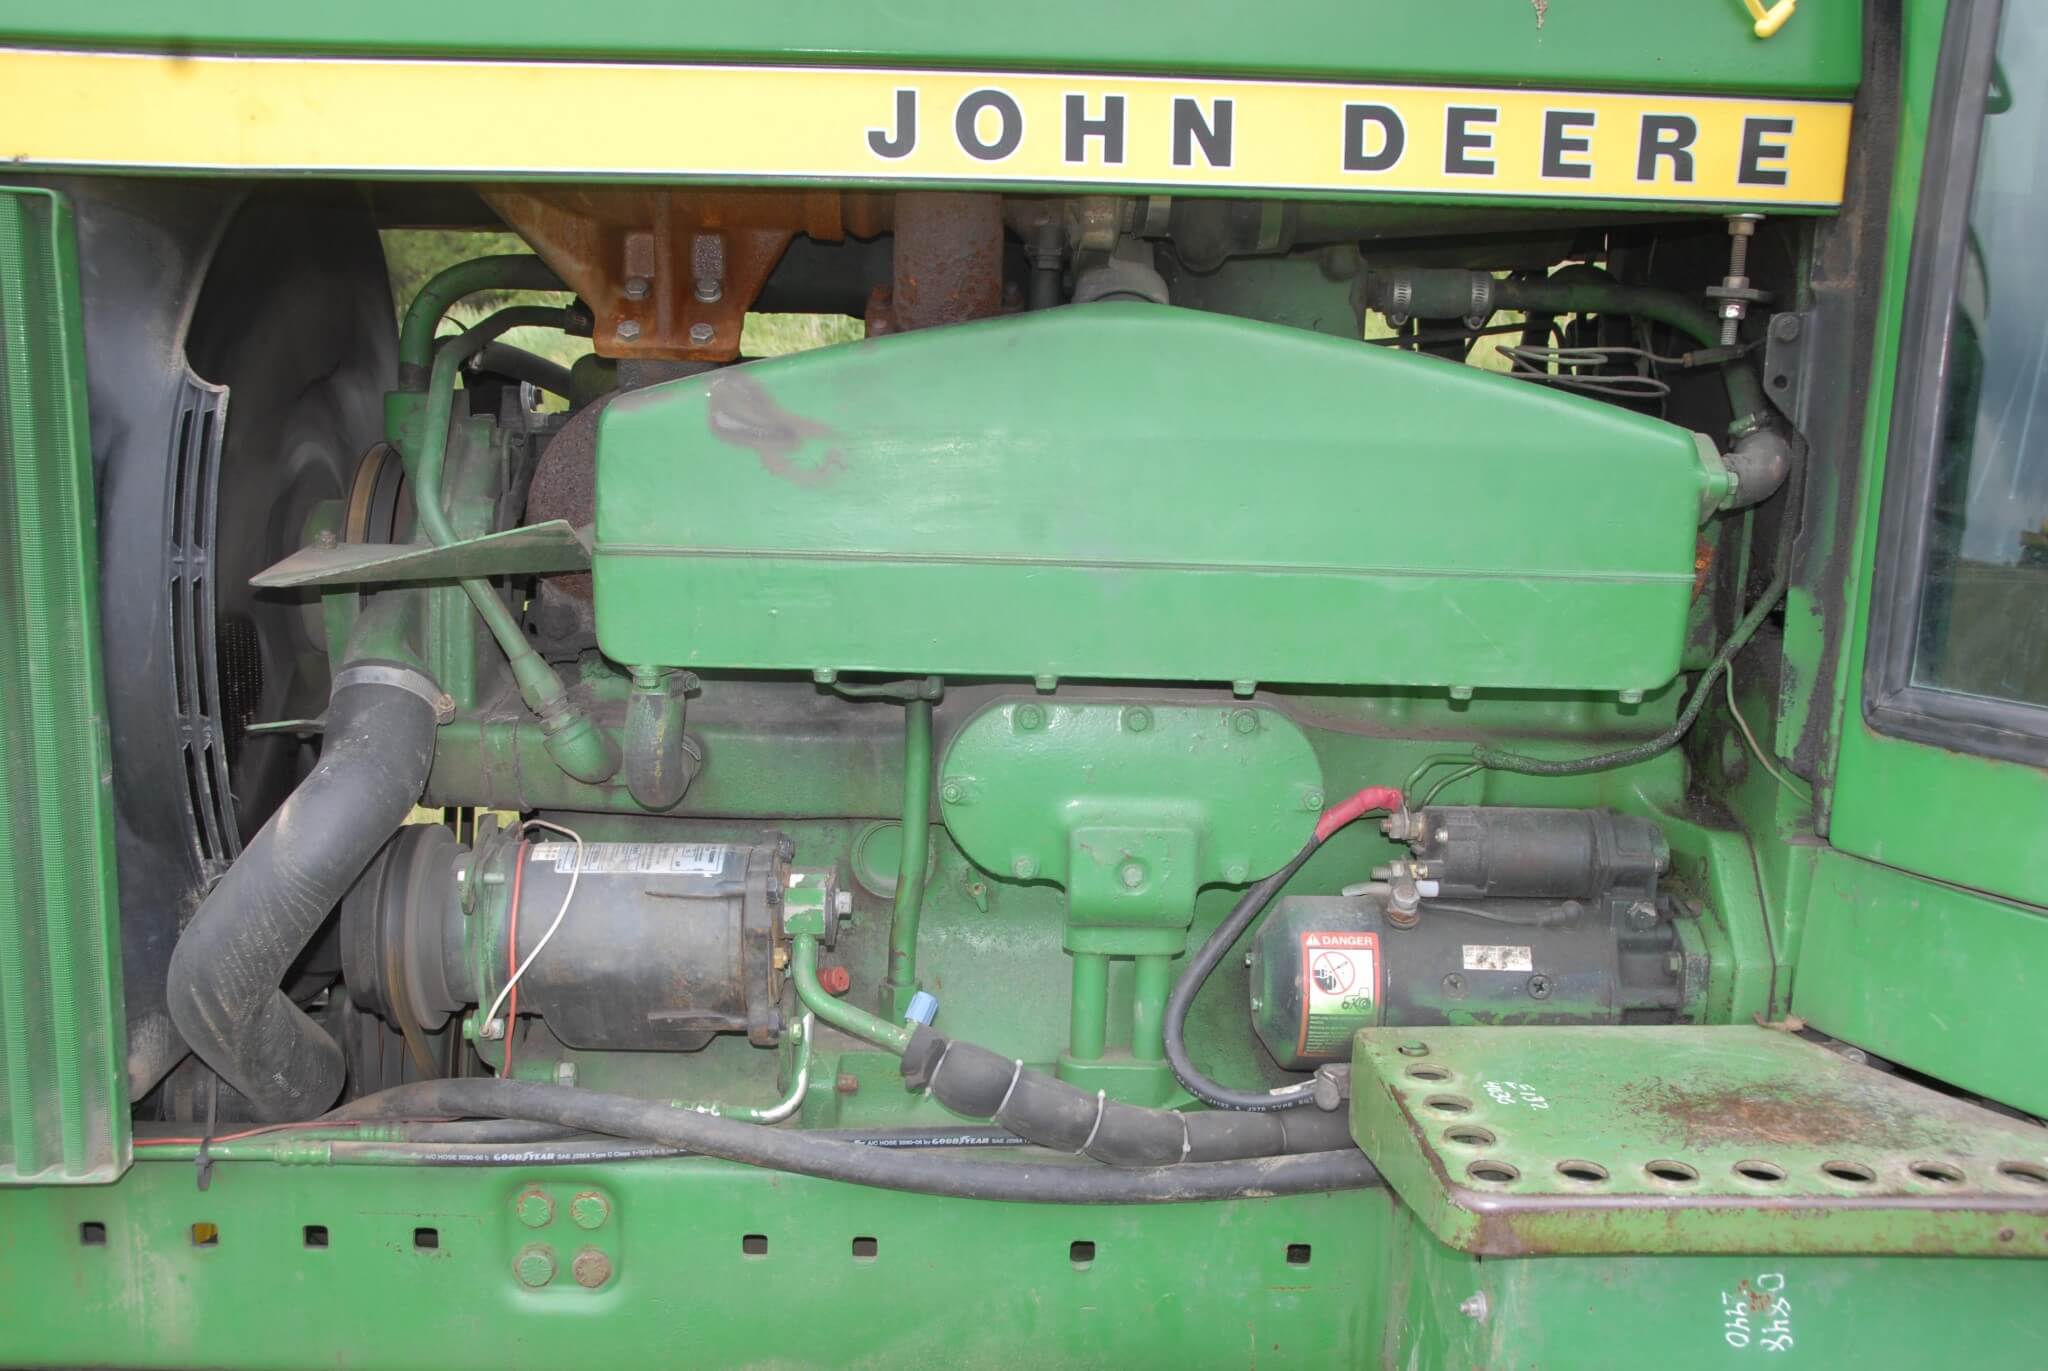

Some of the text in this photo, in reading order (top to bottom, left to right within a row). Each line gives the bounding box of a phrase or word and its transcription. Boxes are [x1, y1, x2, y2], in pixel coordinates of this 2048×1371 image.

[868, 89, 1794, 185] JOHN DEERE
[1322, 935, 1373, 946] DANGER
[1272, 1102, 1294, 1110] TYPE
[932, 1135, 989, 1145] GOODYEAR
[494, 1151, 554, 1161] GOODYEAR
